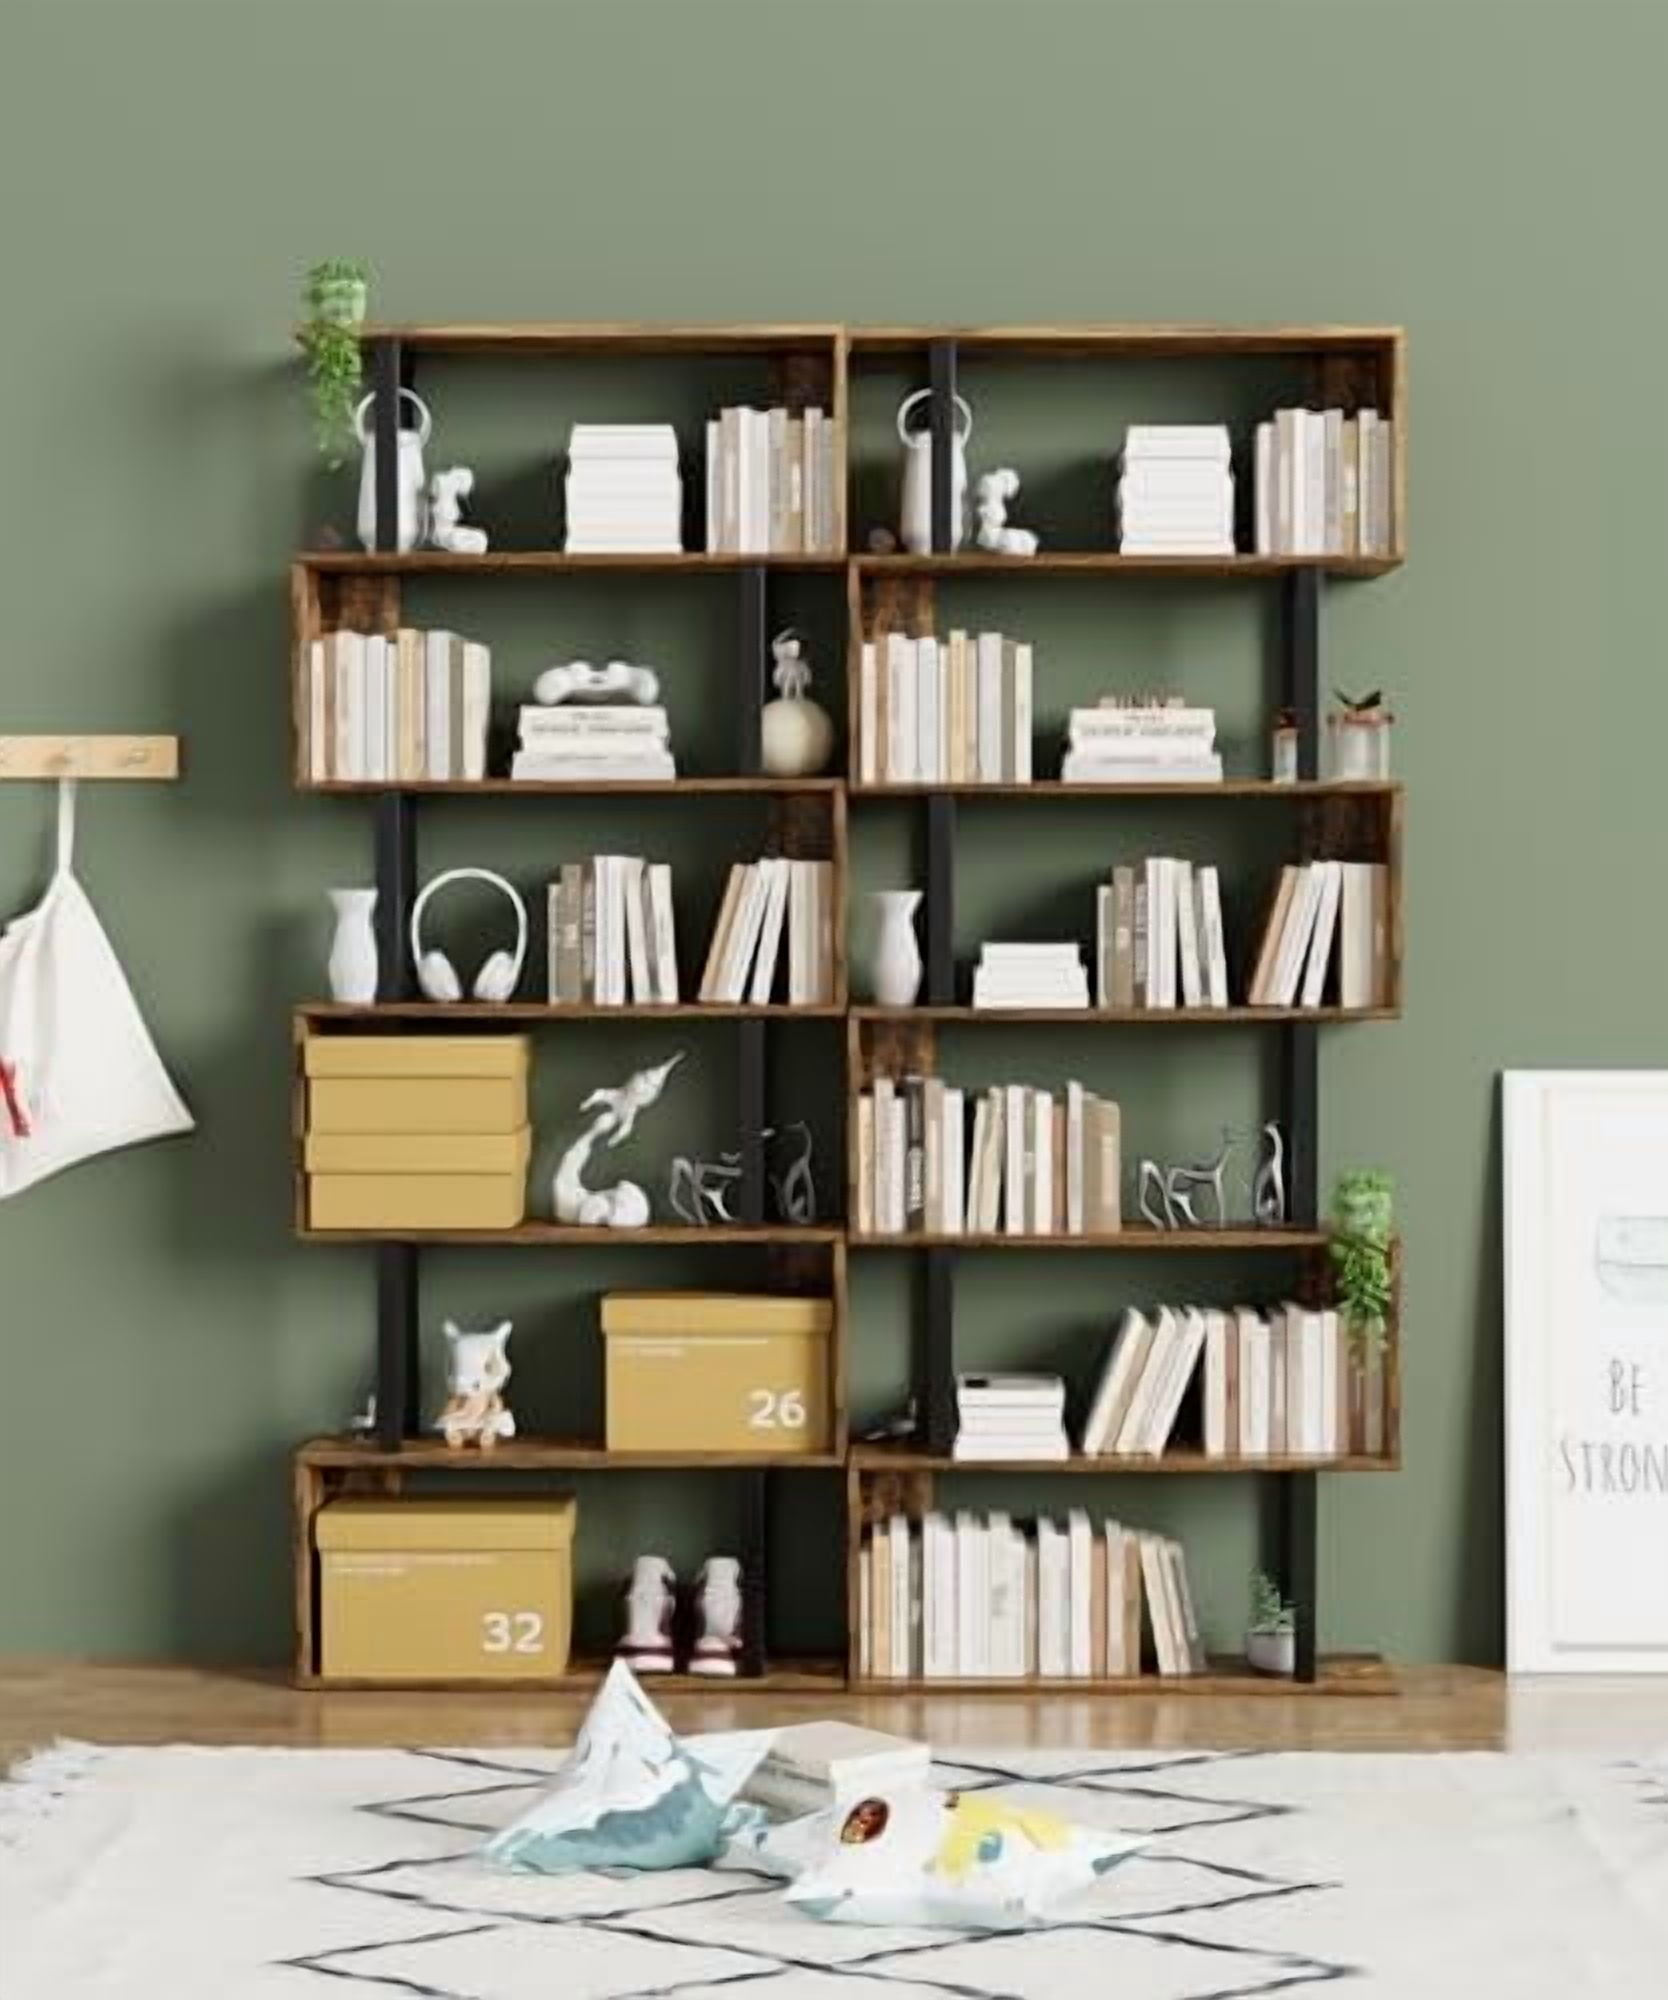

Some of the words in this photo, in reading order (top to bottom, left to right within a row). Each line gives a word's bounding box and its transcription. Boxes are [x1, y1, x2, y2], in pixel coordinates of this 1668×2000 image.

[1609, 1358, 1643, 1416] BE
[749, 1389, 806, 1428] 26
[483, 1611, 543, 1653] 32
